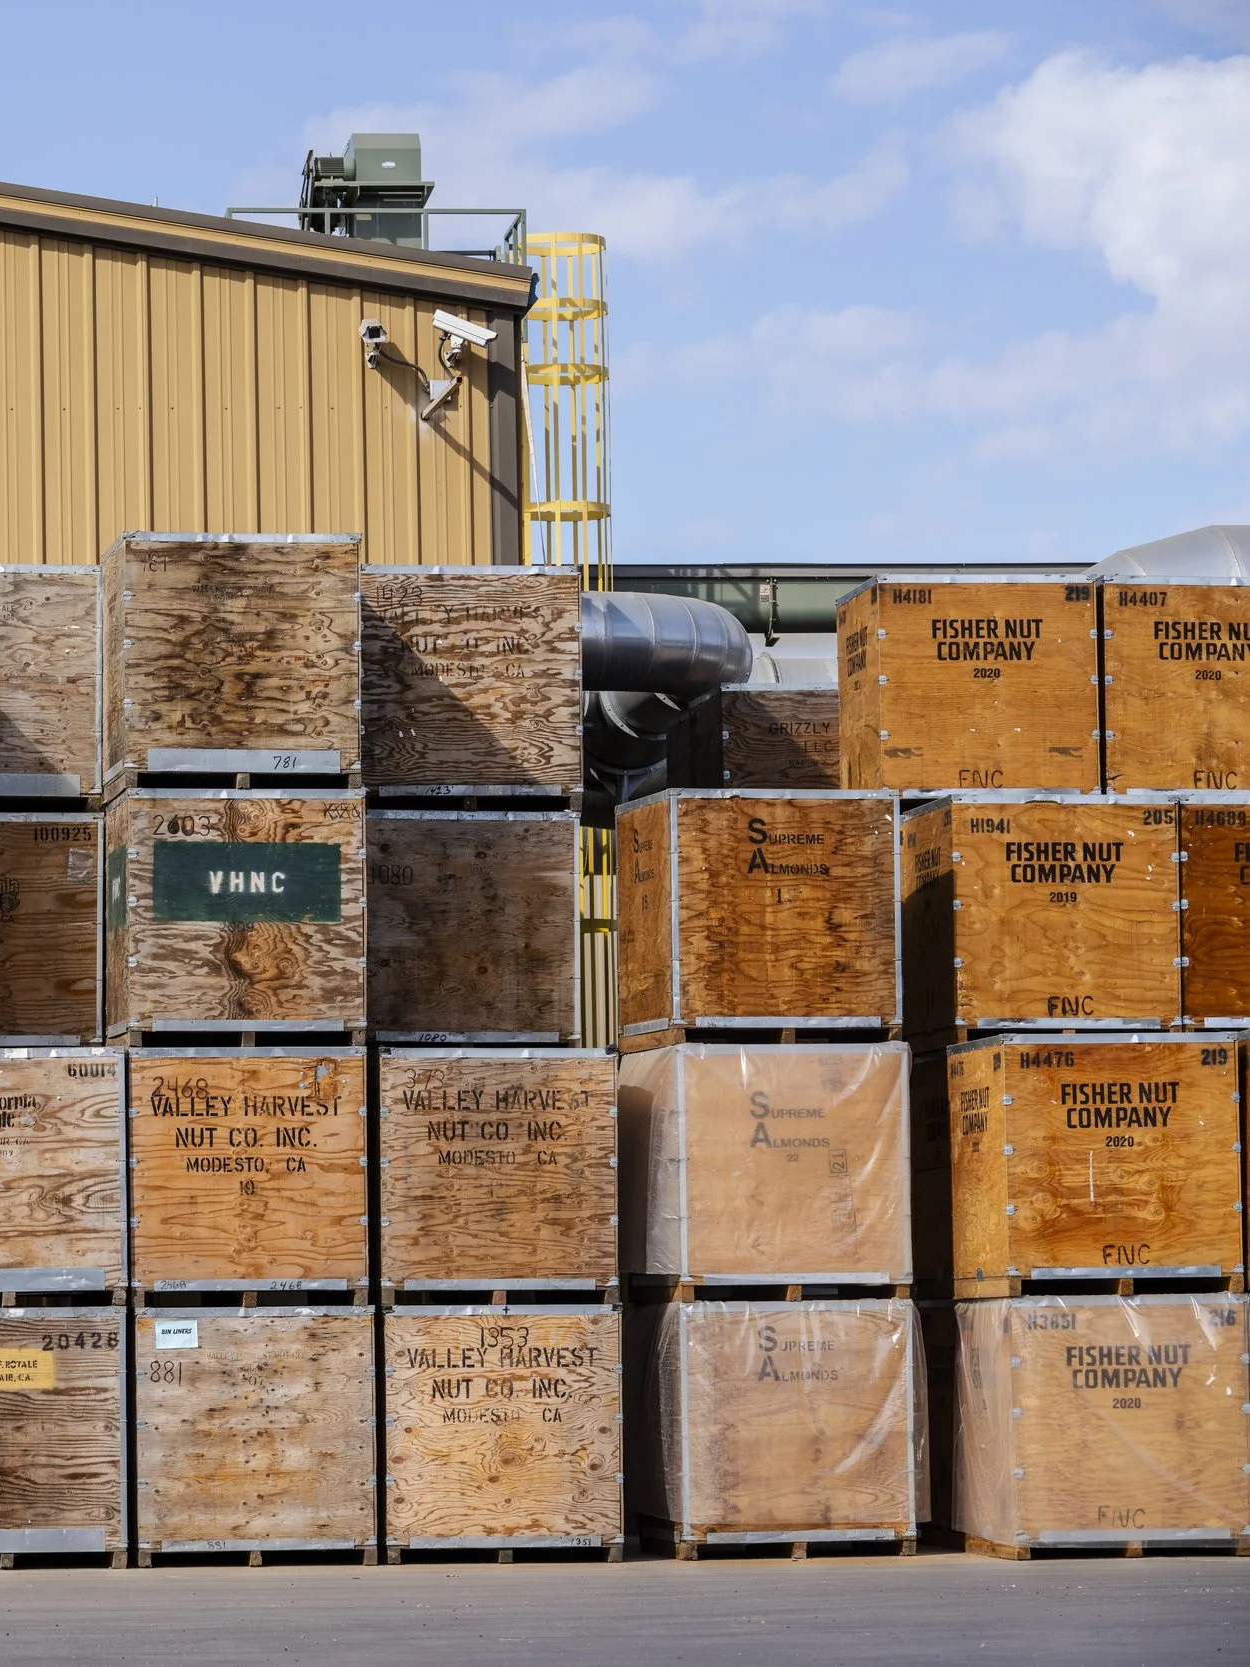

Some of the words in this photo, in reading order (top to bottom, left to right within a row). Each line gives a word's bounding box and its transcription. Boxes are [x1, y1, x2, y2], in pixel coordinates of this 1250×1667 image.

[893, 588, 932, 604] H4181
[1118, 591, 1168, 607] H4407
[377, 605, 456, 623] ALLY
[931, 618, 999, 639] FISHER
[1004, 618, 1043, 639] NUT
[1153, 621, 1223, 641] FISHER
[1228, 622, 1250, 641] NU
[937, 641, 1036, 661] COMPANY
[506, 662, 526, 677] CA
[973, 668, 1001, 679] 2020
[1195, 670, 1222, 681] 2020
[769, 722, 831, 735] GRIZZLY
[273, 755, 297, 770] 781
[958, 769, 1004, 789] FNC
[1194, 770, 1238, 789] FNC
[425, 785, 451, 797] 1423
[970, 818, 1011, 834] H1941
[1142, 809, 1173, 826] 205
[34, 826, 92, 843] 100925
[747, 818, 825, 845] SUPREME
[747, 847, 830, 876] ALMONDS
[1005, 842, 1076, 862] FISHER
[1083, 842, 1124, 862] NUT
[209, 870, 287, 894] VHNC
[1010, 863, 1116, 883] COMPANY
[1049, 892, 1077, 903] 2019
[0, 914, 15, 923] CA
[1047, 995, 1094, 1017] FNC
[419, 1033, 447, 1042] 1080
[1020, 1051, 1075, 1069] H4476
[1200, 1048, 1228, 1066] 219
[152, 1076, 210, 1100] 2468
[404, 1067, 445, 1090] 373
[403, 1089, 484, 1111] VALLEY
[1061, 1082, 1132, 1105] FISHER
[1139, 1081, 1180, 1104] NUT
[150, 1095, 232, 1117] VALLEY
[244, 1095, 342, 1117] HARVEST
[750, 1091, 826, 1119] SUPREME
[1066, 1106, 1172, 1129] COMPANY
[175, 1127, 218, 1148] NUT
[229, 1127, 264, 1148] CO.
[276, 1127, 317, 1148] INC.
[427, 1120, 469, 1142] NUT
[527, 1120, 568, 1142] INC.
[750, 1122, 831, 1149] ALMONDS
[1105, 1136, 1135, 1147] 2020
[286, 1156, 307, 1173] CA
[538, 1150, 558, 1166] CA
[1102, 1243, 1151, 1265] FNC
[270, 1280, 303, 1290] 2468
[42, 1331, 119, 1351] 20428
[172, 1327, 193, 1335] LINERS
[480, 1326, 530, 1349] 1353
[5, 1360, 38, 1369] ROYALE
[407, 1348, 488, 1368] VALLEY
[500, 1347, 598, 1368] HARVEST
[1066, 1345, 1140, 1367] FISHER
[1147, 1344, 1192, 1365] NUT
[150, 1359, 182, 1387] 881
[757, 1355, 839, 1382] ALMONDS
[1072, 1367, 1183, 1389] COMPANY
[432, 1378, 473, 1399] NUT
[532, 1378, 573, 1399] INC.
[1112, 1397, 1142, 1409] 2020
[542, 1407, 563, 1423] CA
